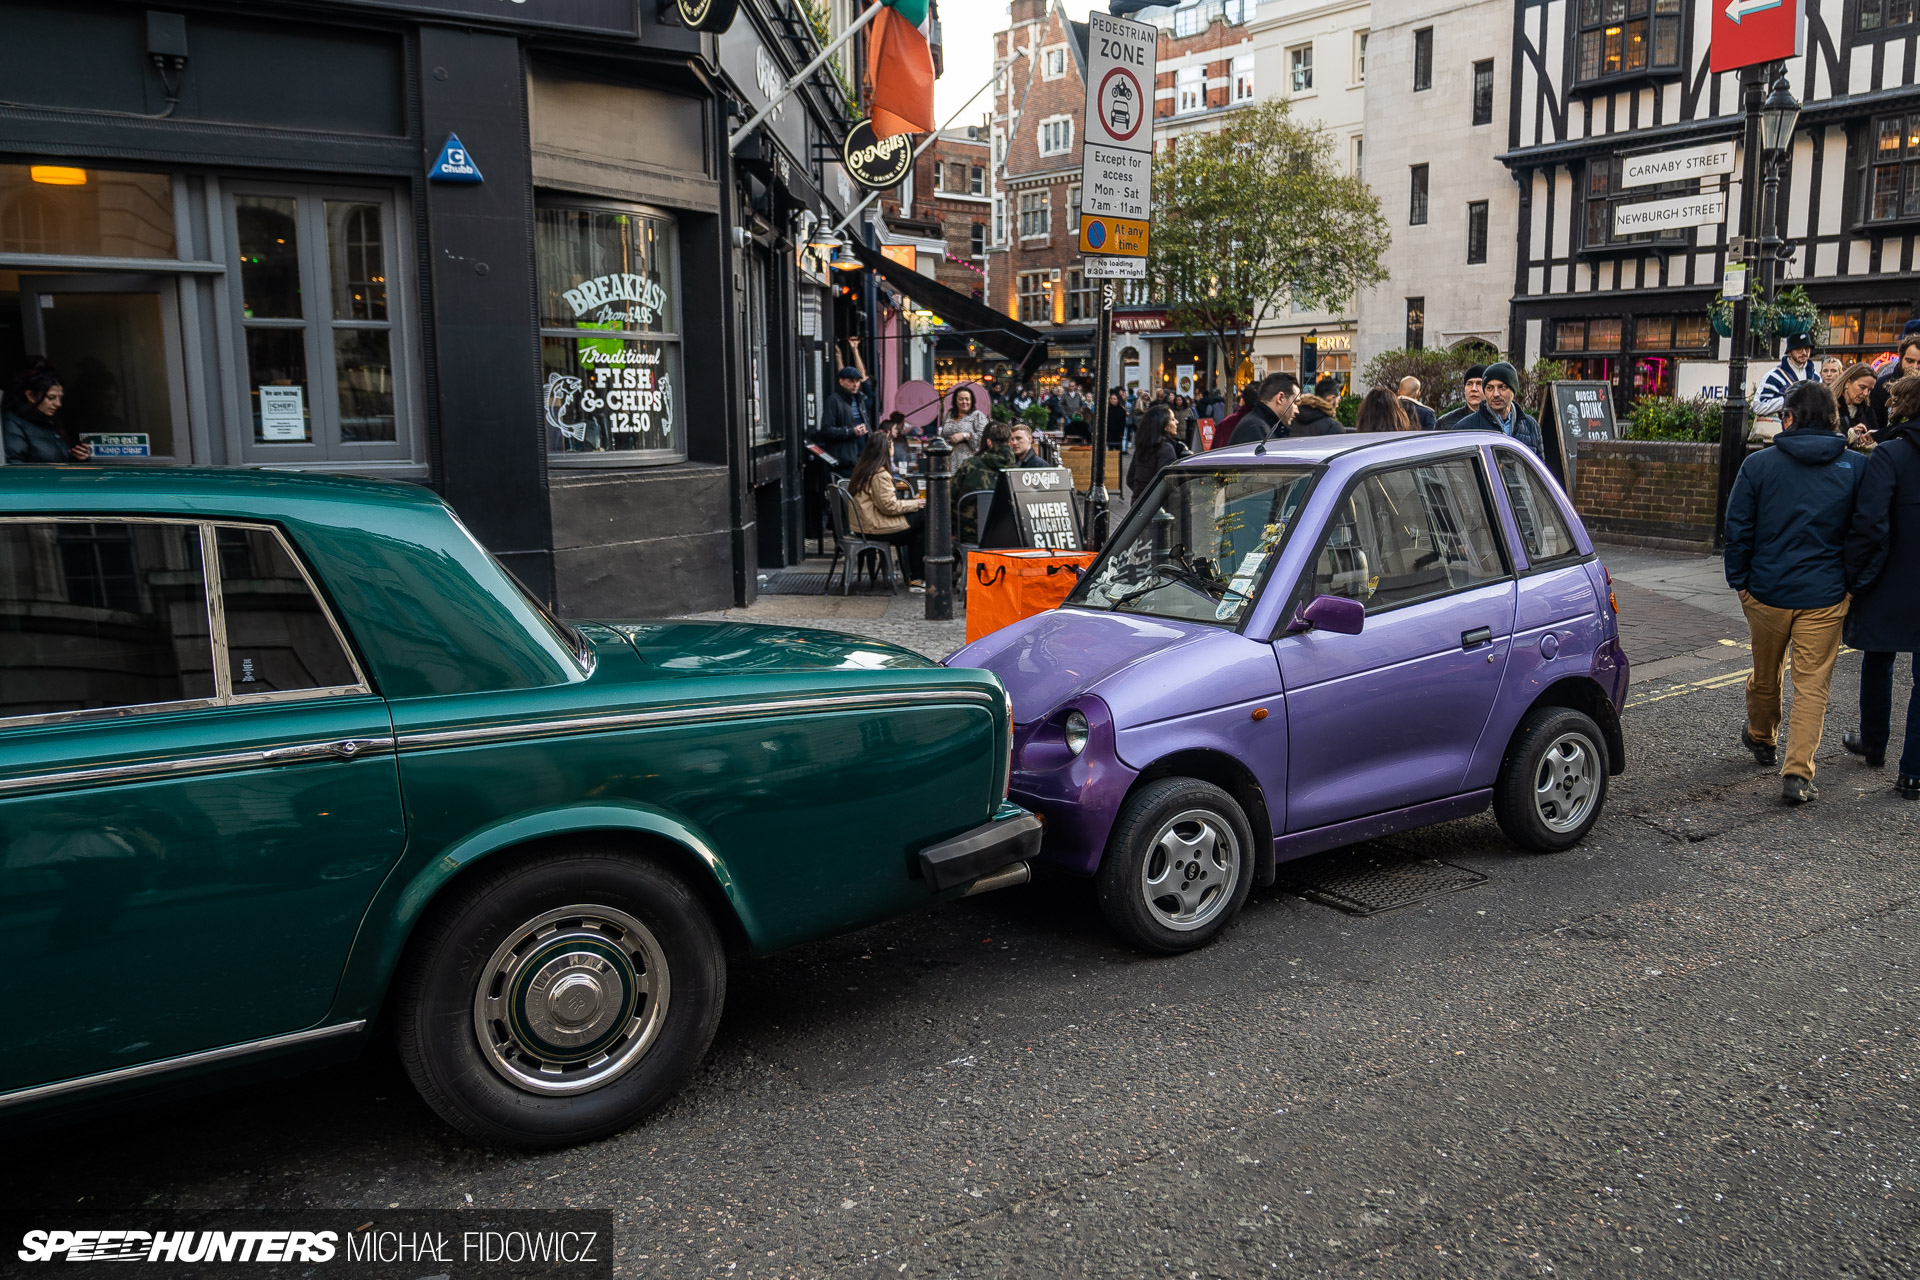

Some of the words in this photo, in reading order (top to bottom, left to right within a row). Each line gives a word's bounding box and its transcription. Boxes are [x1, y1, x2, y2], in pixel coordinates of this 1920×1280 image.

[1092, 18, 1154, 44] PEDESTRIAN
[1100, 38, 1145, 66] ZONE
[1095, 150, 1126, 167] Except
[1129, 156, 1142, 168] for
[1629, 160, 1682, 177] CARNABY
[1686, 152, 1728, 169] STREET
[441, 163, 474, 174] Chubb
[1102, 170, 1133, 183] access
[1094, 183, 1114, 196] Mon
[1123, 187, 1140, 199] Sat
[1617, 208, 1679, 225] NEWBURGH
[1682, 203, 1723, 218] STREET
[1114, 224, 1125, 235] At
[1128, 227, 1143, 238] any
[1119, 240, 1138, 251] time
[1109, 260, 1133, 268] loading
[562, 273, 667, 317] BREAKFAST
[597, 304, 629, 326] from
[579, 345, 661, 365] Traditional
[594, 367, 652, 389] FISH
[581, 389, 604, 413] &
[606, 389, 662, 412] CHIPS
[1575, 390, 1598, 402] BURGER
[1598, 388, 1606, 401] &
[1580, 401, 1605, 419] DRINK
[609, 412, 651, 433] 12.50
[101, 435, 120, 445] Fire
[120, 436, 139, 445] exit
[98, 445, 121, 455] Keep
[122, 446, 143, 455] clear
[1022, 471, 1060, 490] O'Neill's
[1026, 501, 1070, 518] WHERE
[1030, 517, 1073, 533] LAUGHTER
[1045, 531, 1077, 549] LIFE
